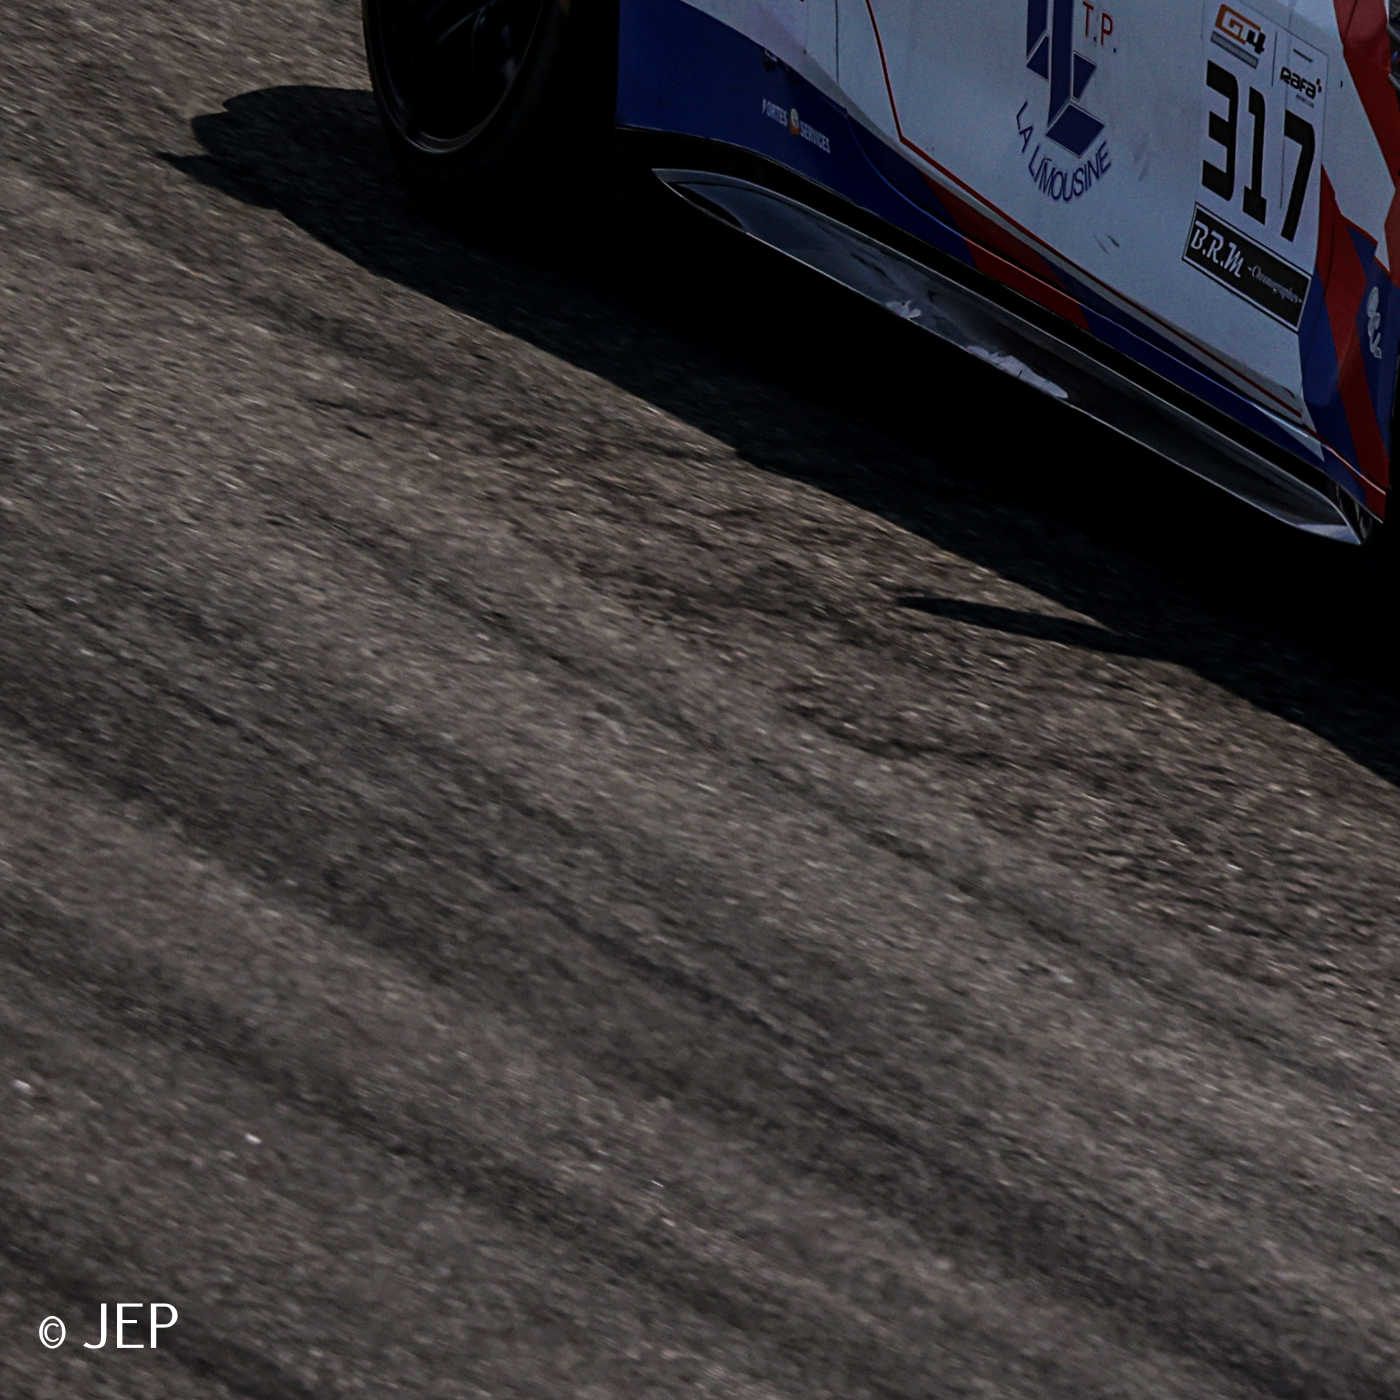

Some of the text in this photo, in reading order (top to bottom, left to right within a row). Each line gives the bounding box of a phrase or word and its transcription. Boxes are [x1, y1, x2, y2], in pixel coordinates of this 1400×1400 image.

[1016, 100, 1112, 202] LA LIMOUSINE
[1201, 59, 1316, 243] 317
